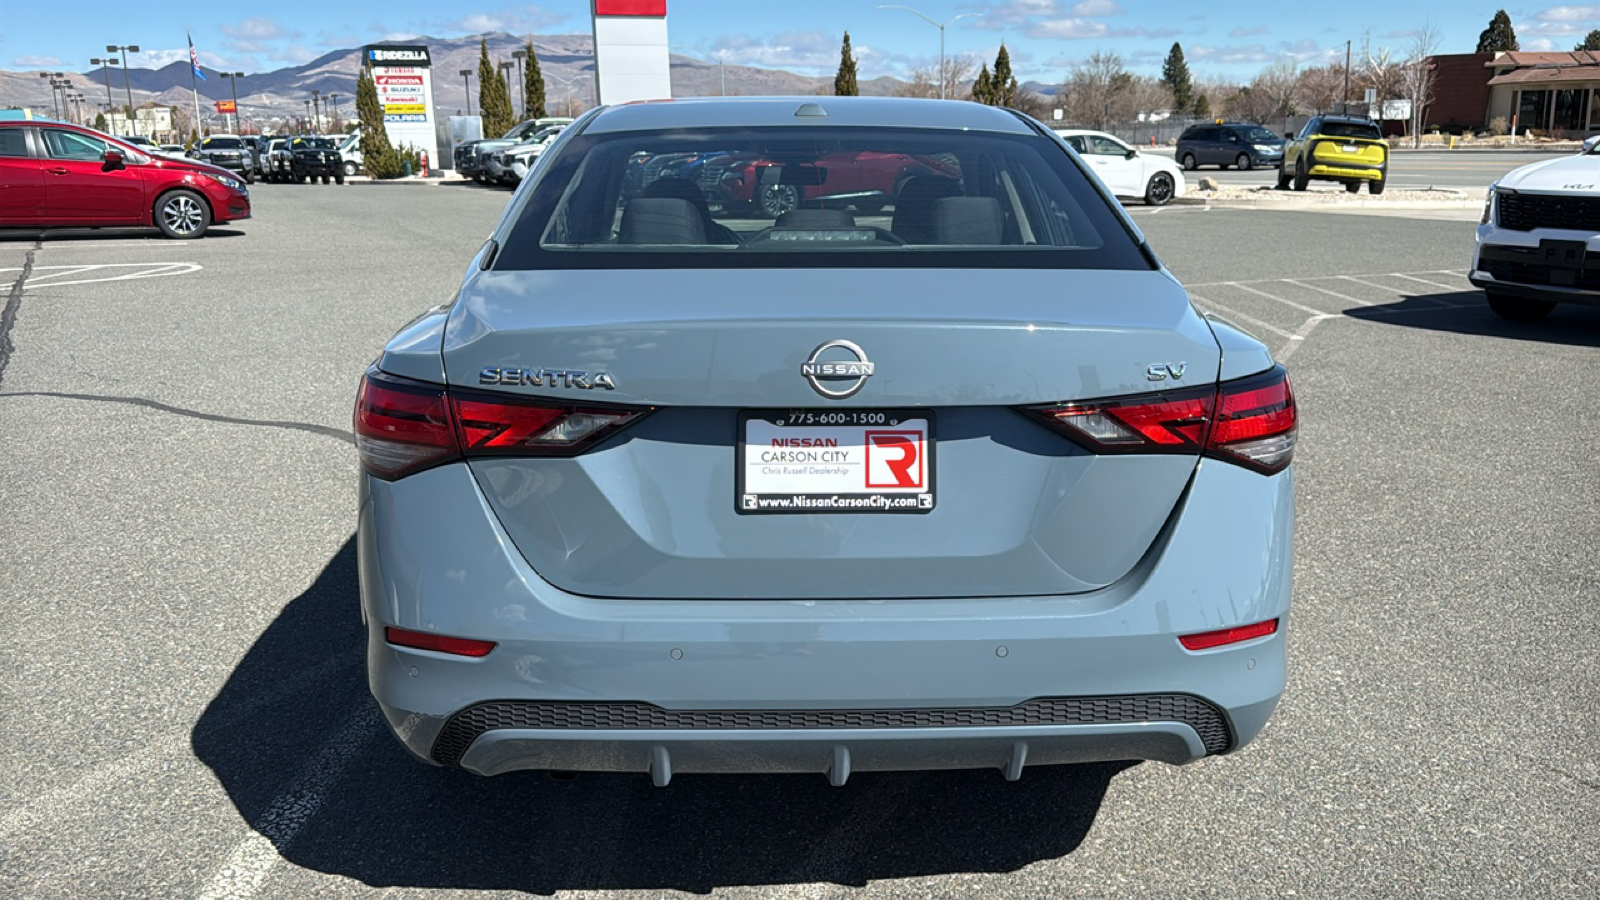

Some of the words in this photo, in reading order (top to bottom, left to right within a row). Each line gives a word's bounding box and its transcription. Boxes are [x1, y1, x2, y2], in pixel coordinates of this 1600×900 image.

[383, 50, 428, 60] RIDEZILLA
[803, 364, 872, 375] NISSAN
[1146, 361, 1188, 381] SV
[479, 366, 615, 390] SENTRA
[789, 413, 885, 424] 775-600-1500
[771, 438, 838, 448] NISSAN
[760, 451, 817, 462] CARSON
[821, 451, 849, 462] CITY
[762, 466, 781, 475] Chris
[783, 466, 808, 475] Russell
[809, 466, 849, 476] Dealership
[759, 495, 917, 510] www.NissanCarsonCity.com
